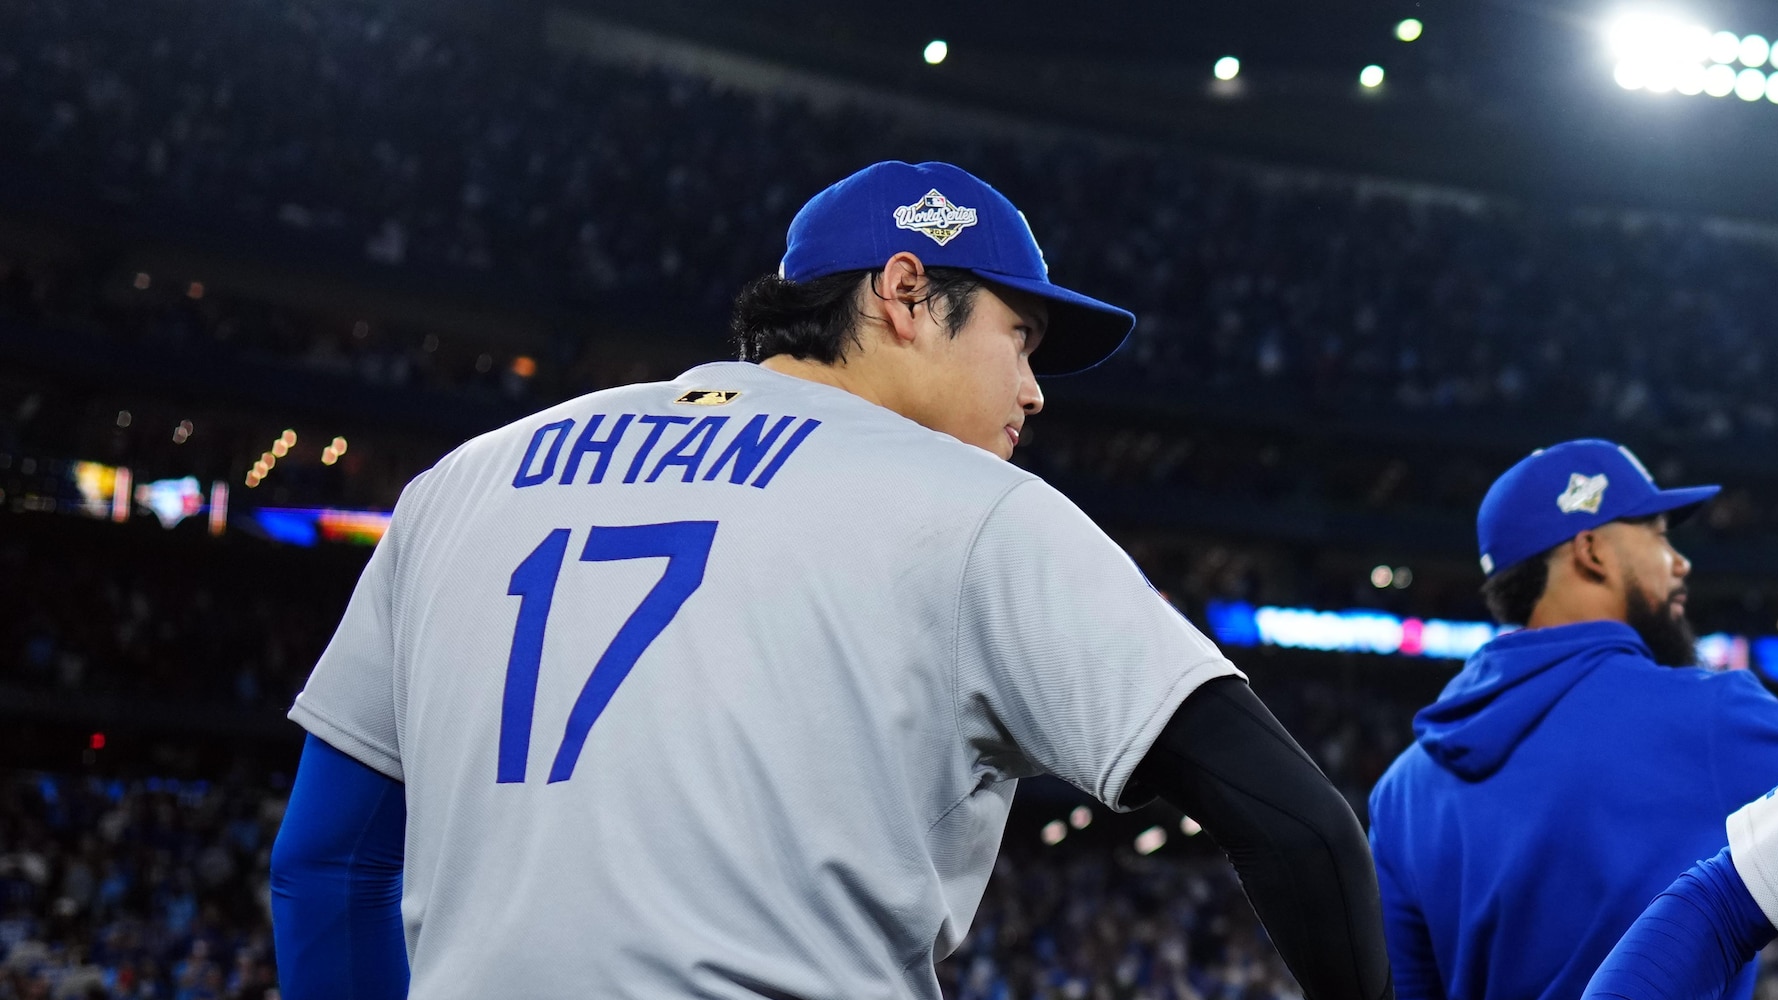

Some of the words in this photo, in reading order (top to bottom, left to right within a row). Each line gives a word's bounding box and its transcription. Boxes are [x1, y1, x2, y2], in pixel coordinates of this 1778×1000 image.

[896, 206, 941, 227] World
[938, 206, 977, 229] Series
[511, 412, 822, 489] OHTANI
[496, 520, 720, 786] 17
